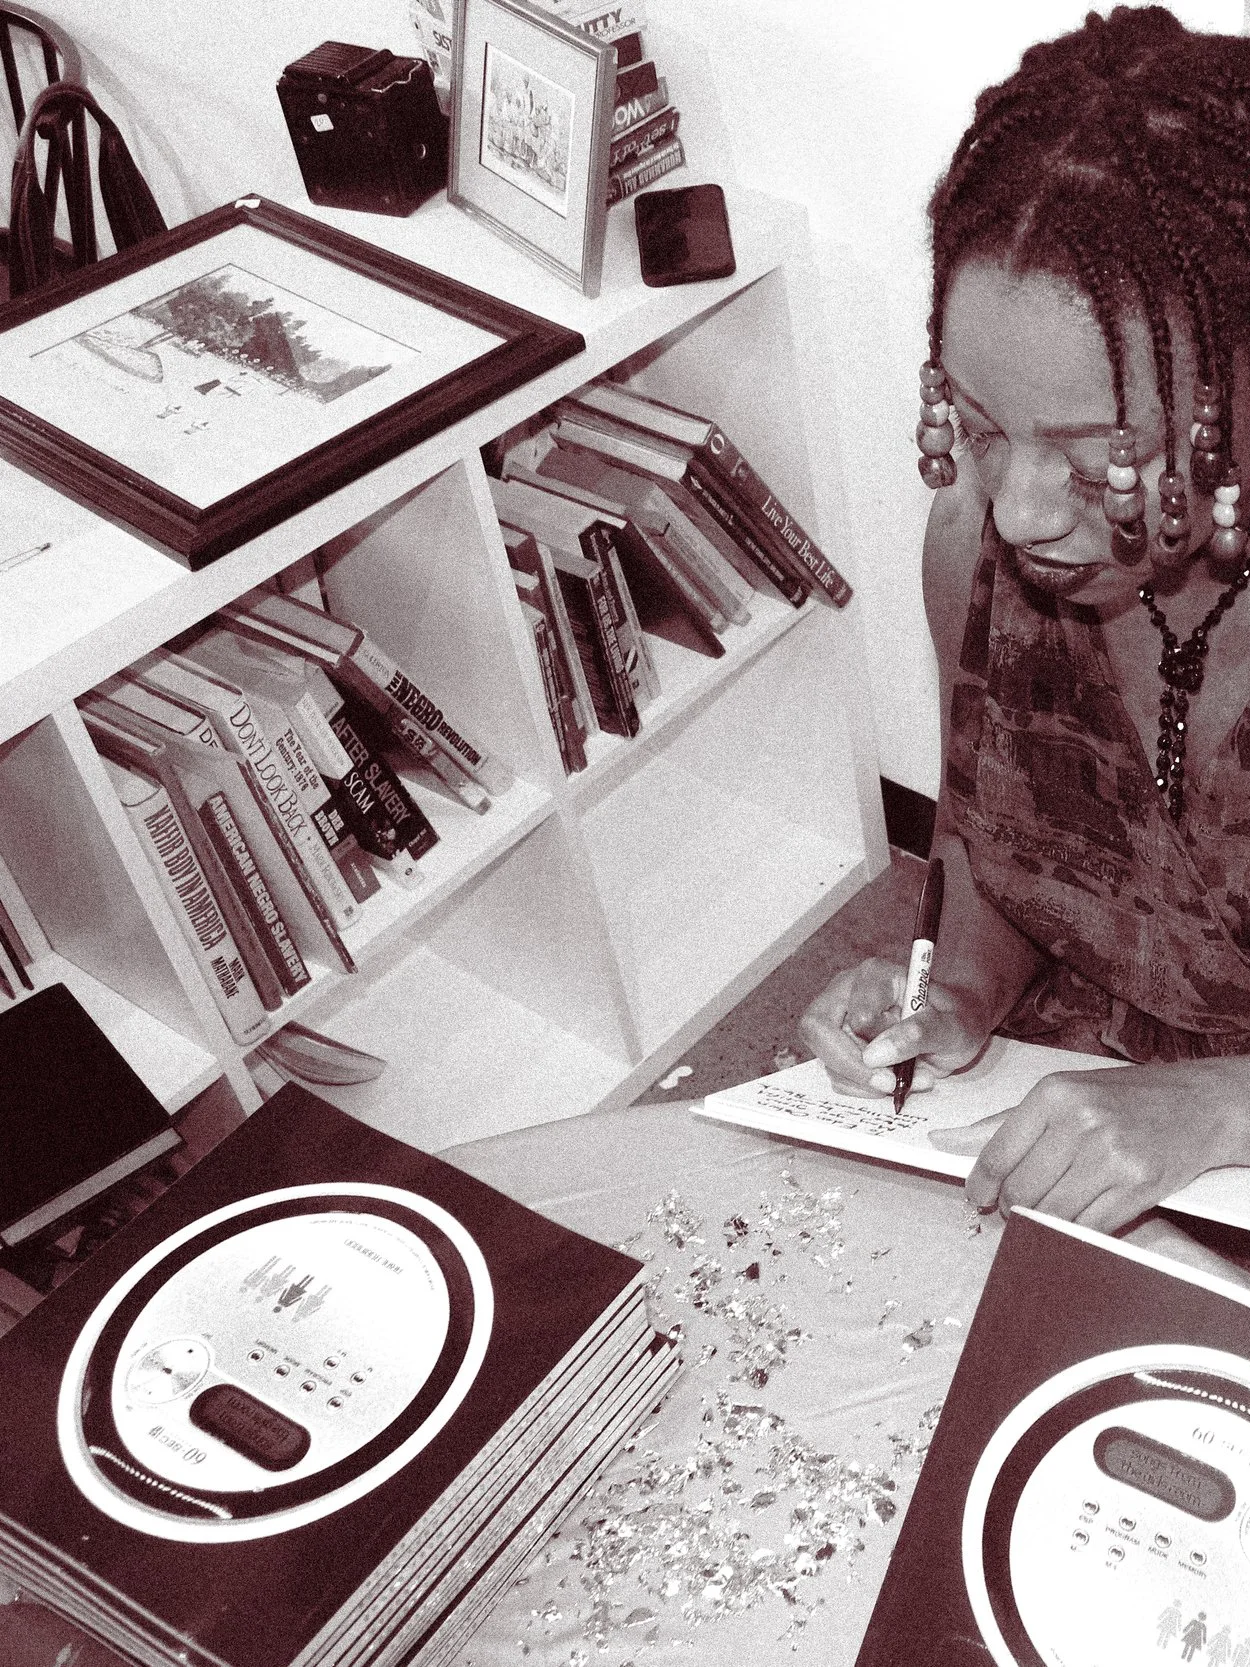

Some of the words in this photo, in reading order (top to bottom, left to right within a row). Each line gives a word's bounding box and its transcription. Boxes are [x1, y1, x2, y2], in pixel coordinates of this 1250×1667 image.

[578, 9, 622, 34] UTTY
[760, 495, 786, 527] Live
[778, 517, 804, 548] Your
[798, 542, 822, 570] Best
[814, 561, 837, 588] Life
[384, 670, 405, 694] THE
[391, 678, 445, 732] NEGRO
[283, 728, 298, 748] The
[292, 744, 308, 767] Year
[437, 723, 481, 766] REVOLUTION
[303, 764, 314, 778] of
[308, 774, 320, 790] the
[330, 716, 370, 769] AFTER
[362, 762, 411, 825] SLAVERY
[253, 750, 288, 801] LOOK
[277, 792, 308, 838] BACK
[343, 771, 375, 815] SCAM
[143, 804, 186, 860] KAFFIR
[314, 810, 339, 846] BROWN
[327, 809, 345, 831] DEE
[163, 849, 196, 884] BOY
[176, 874, 204, 900] IN
[208, 795, 255, 875] AMERICAN
[247, 873, 279, 924] NEGRO
[270, 923, 307, 984] SLAVERY
[182, 889, 227, 951] AMERICA
[210, 956, 239, 999] MATHABANE
[229, 958, 245, 983] MARK
[911, 968, 928, 1010] Sharpie
